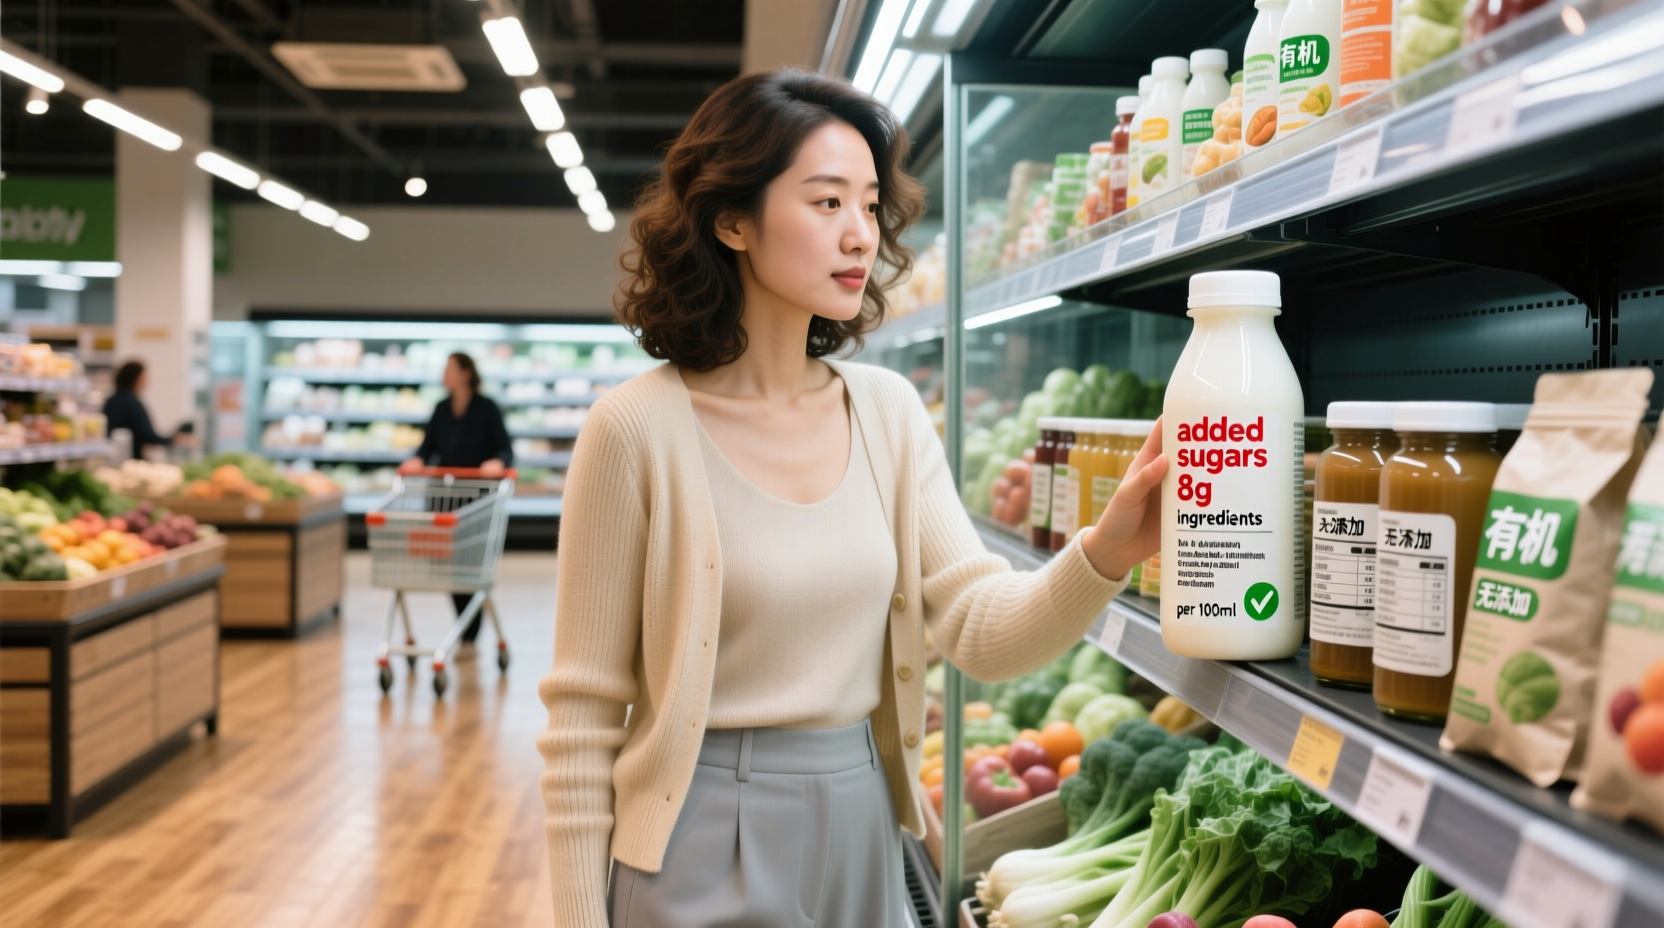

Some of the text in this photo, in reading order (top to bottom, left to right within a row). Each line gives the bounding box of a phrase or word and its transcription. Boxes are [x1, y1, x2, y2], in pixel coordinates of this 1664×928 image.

[1281, 39, 1321, 69] 有机
[1177, 416, 1264, 442] added
[1177, 448, 1268, 474] sugars
[1177, 474, 1212, 507] 8g
[1177, 510, 1263, 528] ingredients
[1485, 505, 1562, 568] 有机
[1177, 602, 1237, 619] per 100ml
[1475, 581, 1532, 617] 无添加
